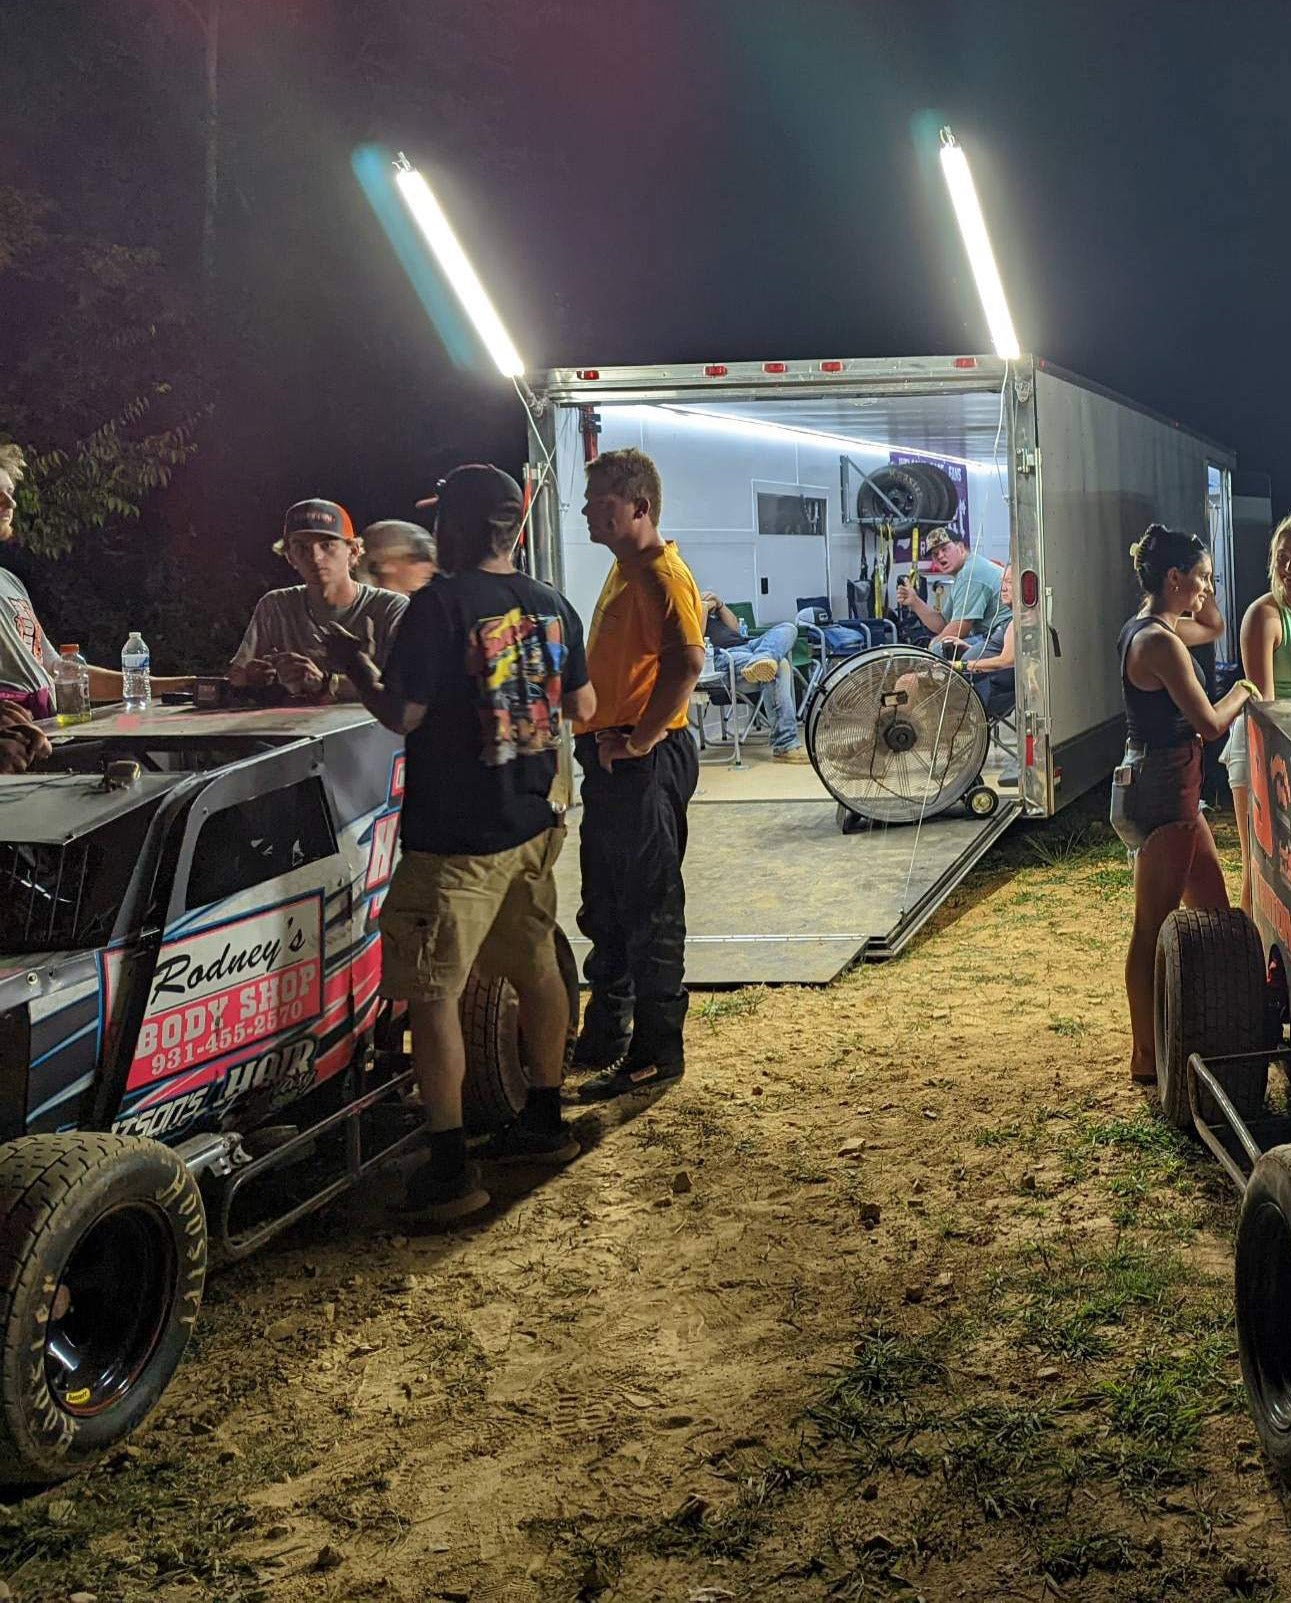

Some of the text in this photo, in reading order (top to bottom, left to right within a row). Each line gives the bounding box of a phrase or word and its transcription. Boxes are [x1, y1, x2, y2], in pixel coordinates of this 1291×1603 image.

[150, 916, 306, 1004] Rodney's
[137, 963, 317, 1057] BODY SHOP
[151, 1000, 304, 1076] 931-455-2570
